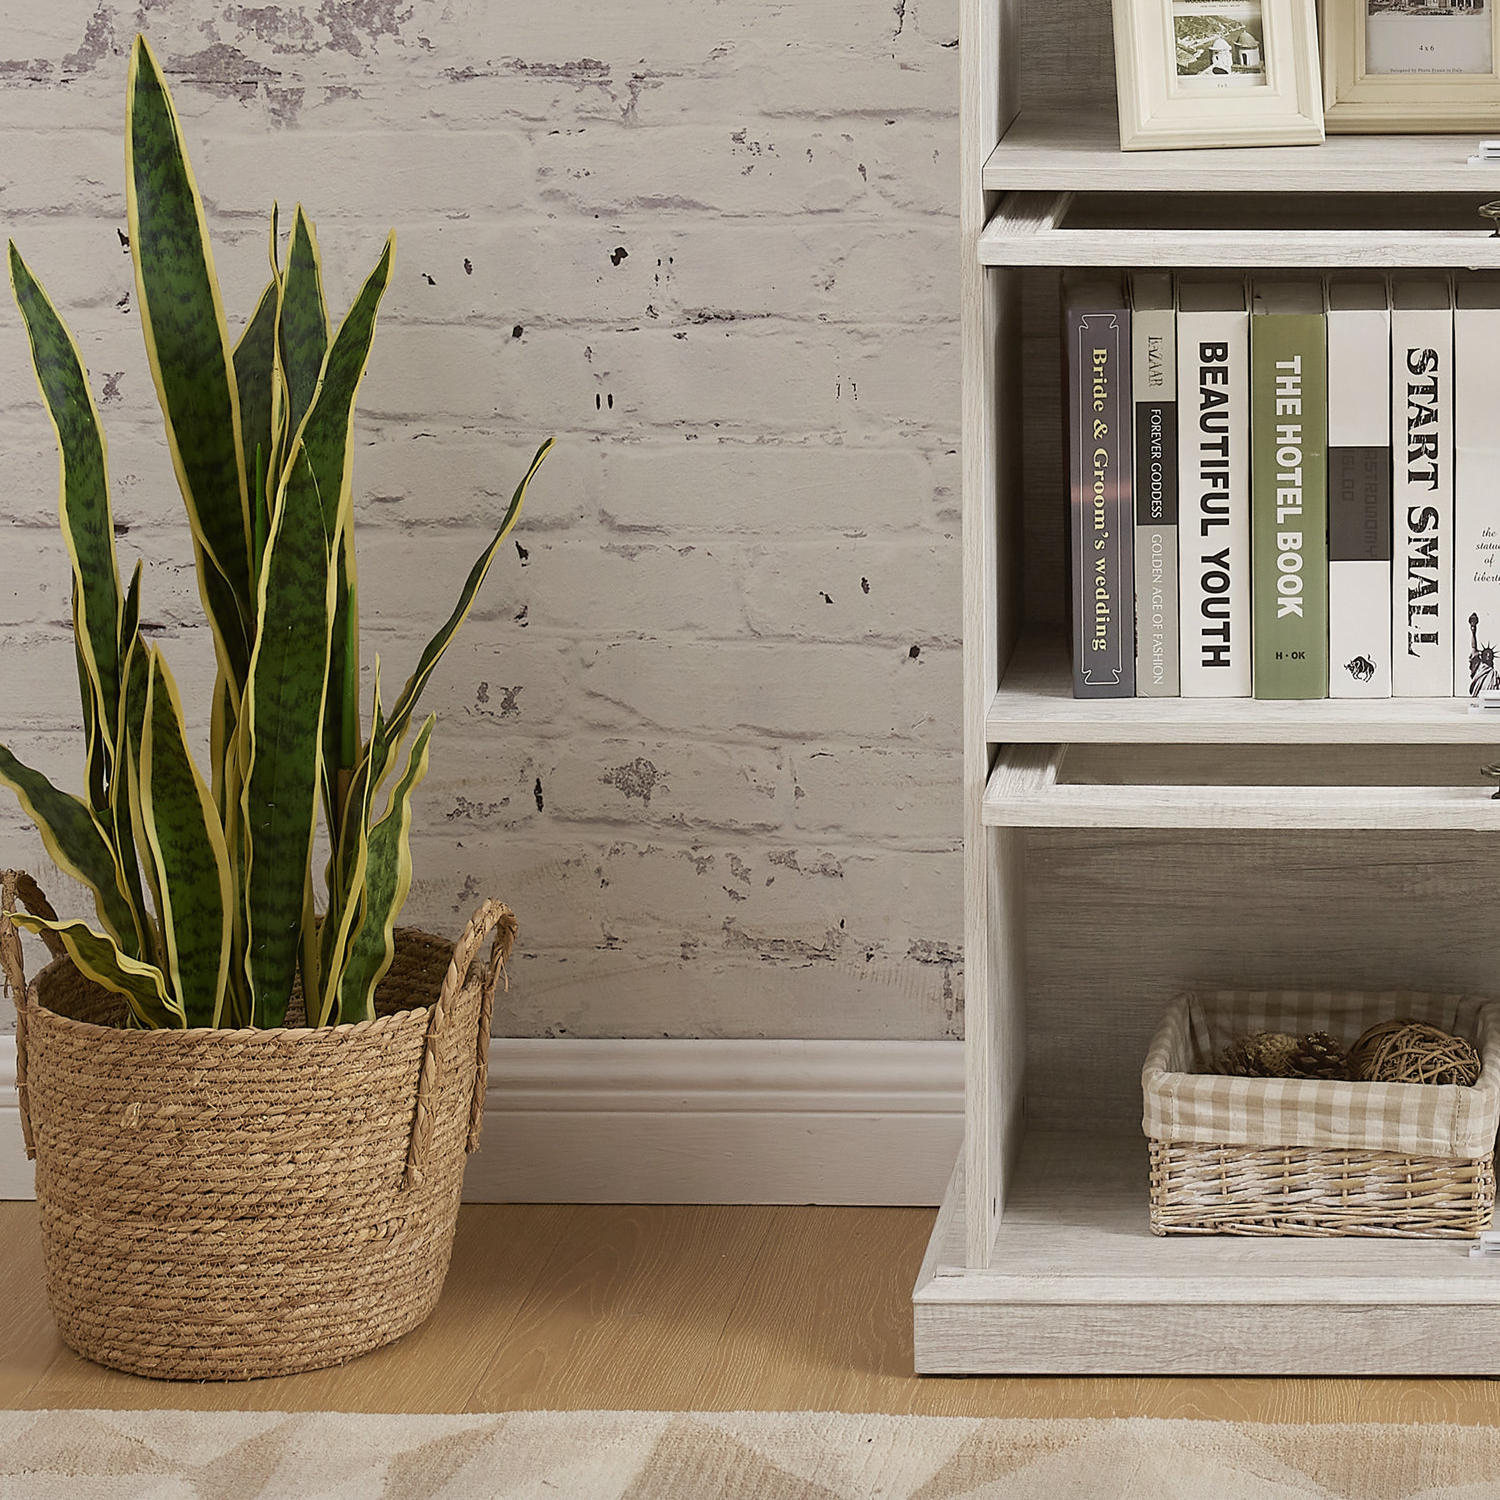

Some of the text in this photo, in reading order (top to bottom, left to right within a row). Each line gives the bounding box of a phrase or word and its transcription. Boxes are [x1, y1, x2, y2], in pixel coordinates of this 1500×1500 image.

[1092, 348, 1108, 412] Bride
[1092, 419, 1109, 441] &
[1151, 410, 1162, 517] FOREVER GODDESS
[1200, 342, 1230, 667] BEAUTIFUL YOUTH
[1276, 356, 1303, 618] THE HOTEL BOOK
[1407, 348, 1439, 657] START SMALL
[1482, 527, 1497, 537] the
[1484, 553, 1496, 568] of
[1092, 557, 1110, 652] wedding
[1152, 534, 1163, 684] GOLDEN AGE OF FASHION
